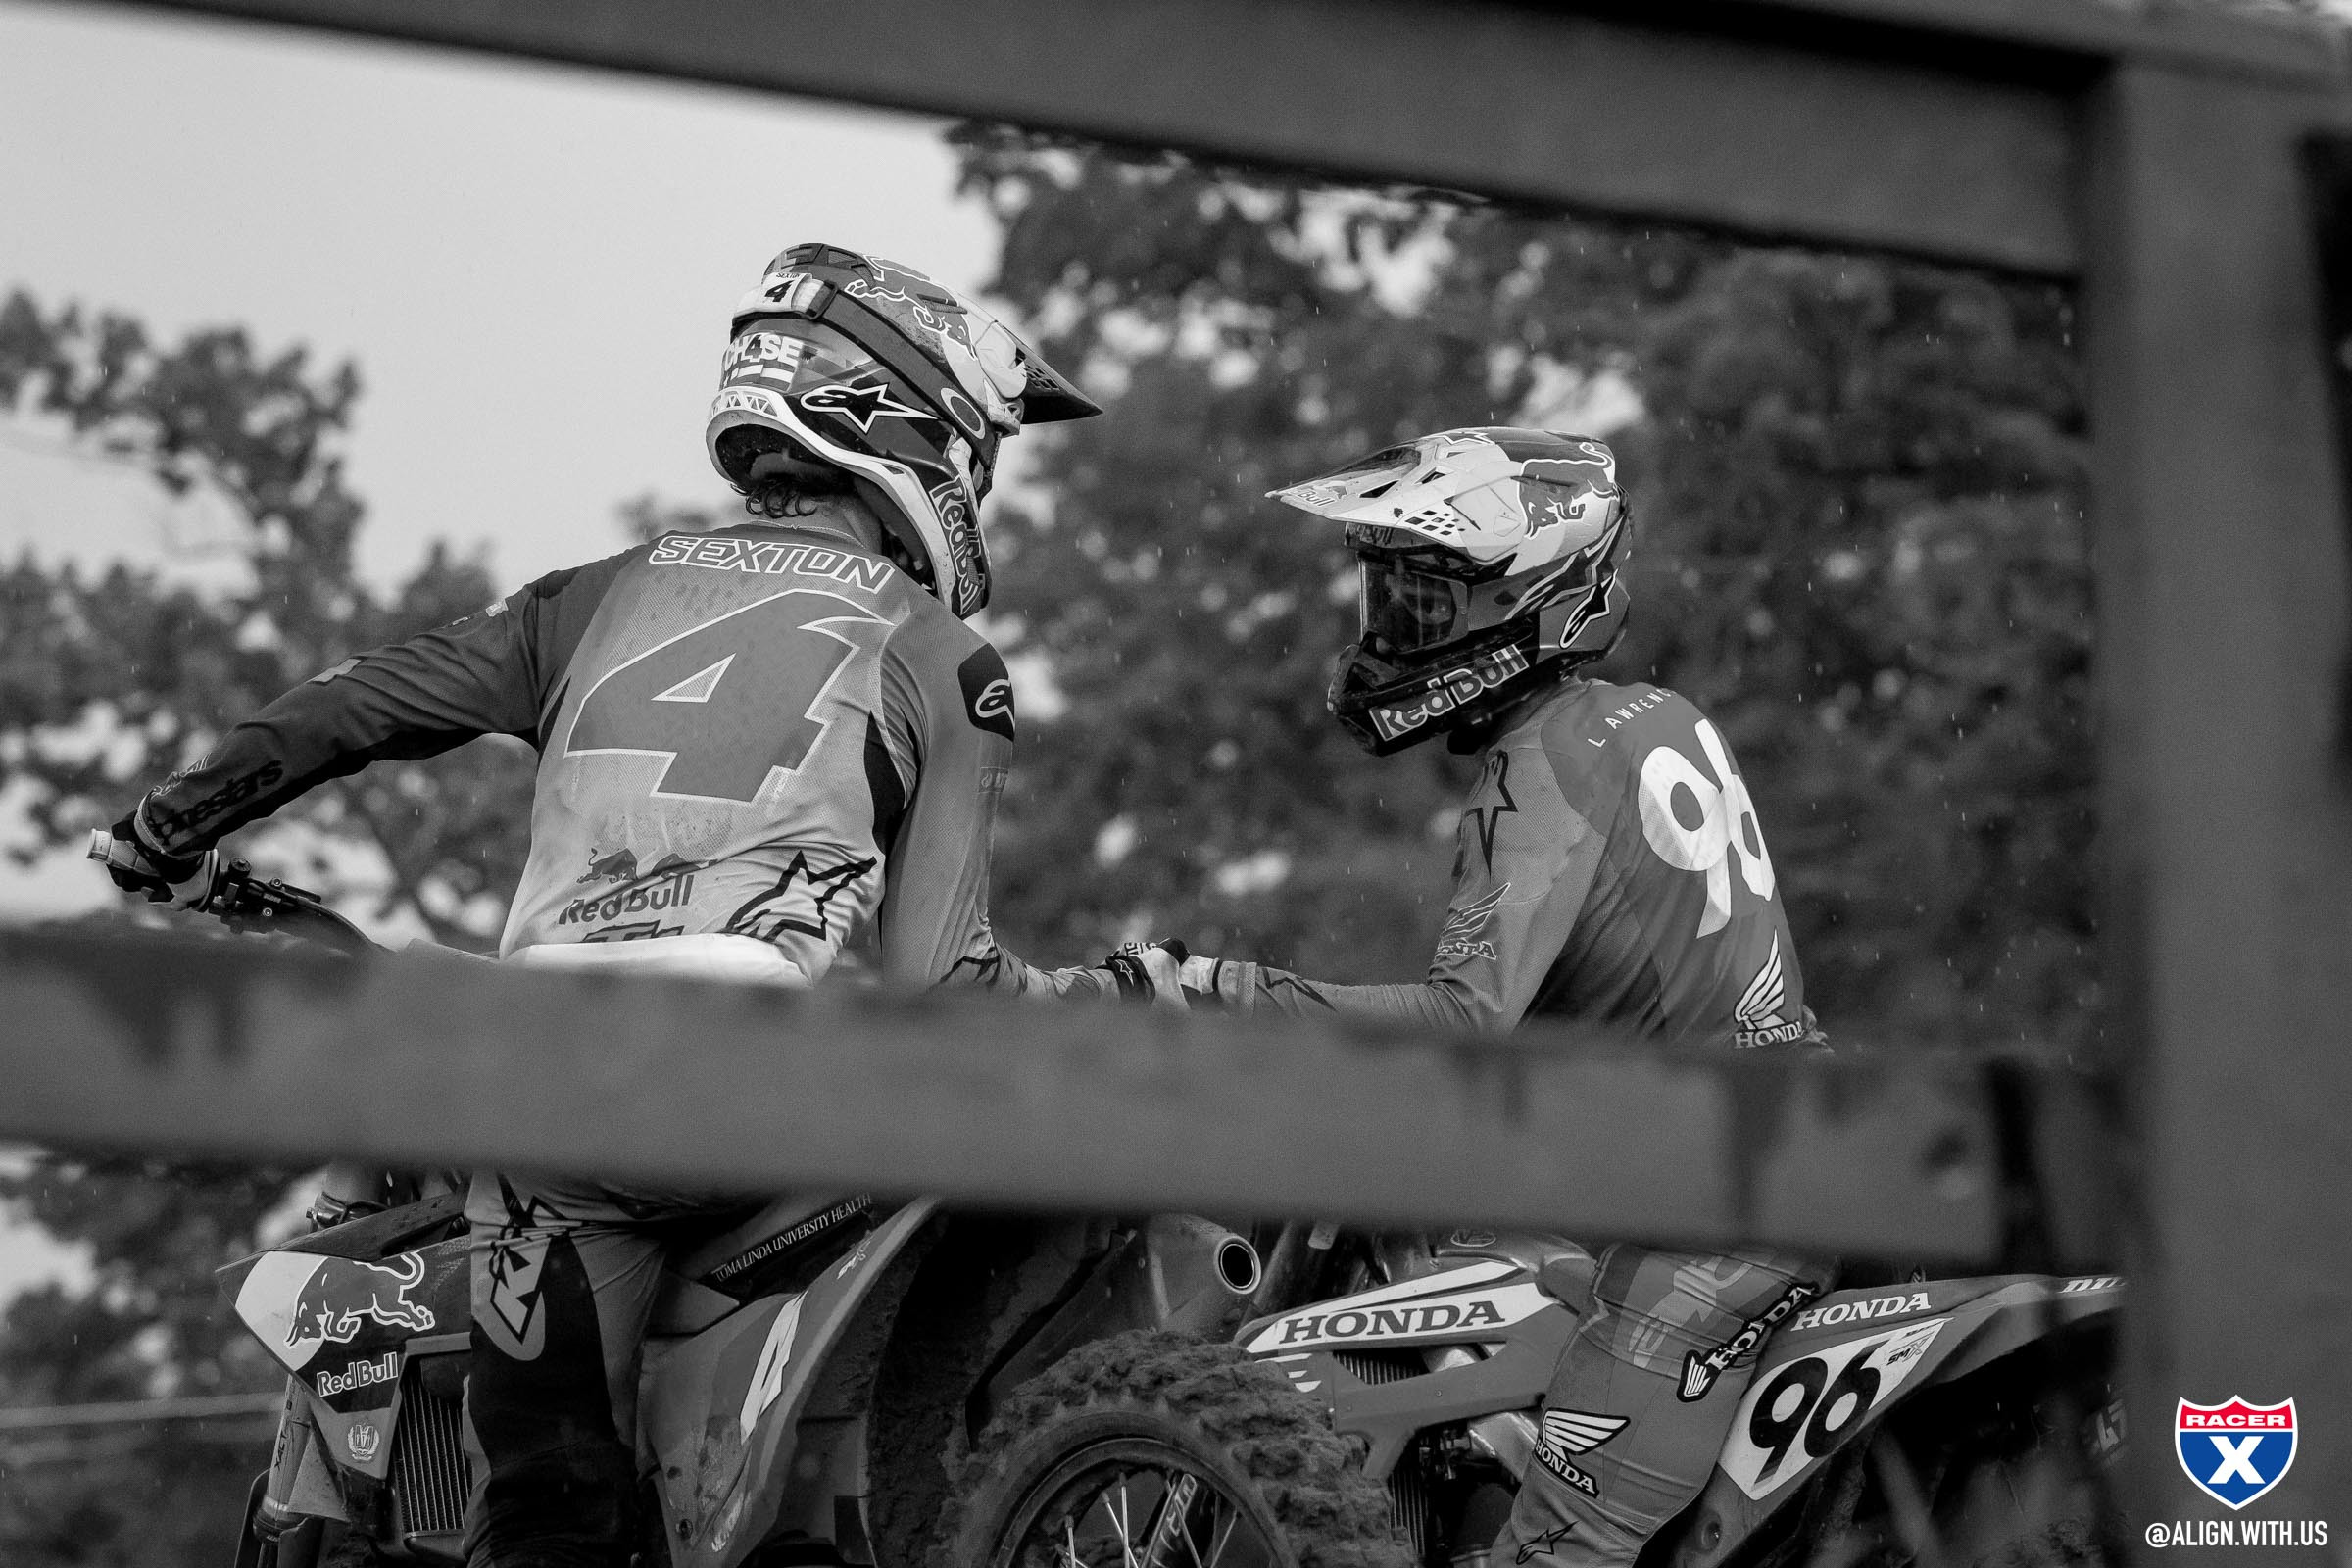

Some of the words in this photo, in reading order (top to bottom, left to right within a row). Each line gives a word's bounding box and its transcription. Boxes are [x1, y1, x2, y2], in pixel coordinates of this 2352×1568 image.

[765, 279, 795, 303] 4
[649, 535, 895, 595] SEXTON
[564, 588, 896, 805] 4
[1638, 718, 1776, 939] 96
[558, 892, 624, 925] Red
[623, 874, 695, 913] Bull
[742, 1243, 773, 1268] LINDA
[772, 1212, 832, 1251] UNIVERSITY
[830, 1193, 872, 1224] HEALTH
[1280, 1299, 1505, 1345] HONDA
[1790, 1292, 1932, 1332] HONDA
[317, 1363, 358, 1397] Red
[357, 1352, 399, 1386] Bull
[1749, 1339, 1890, 1485] 96
[1535, 1439, 1596, 1494] HONDA
